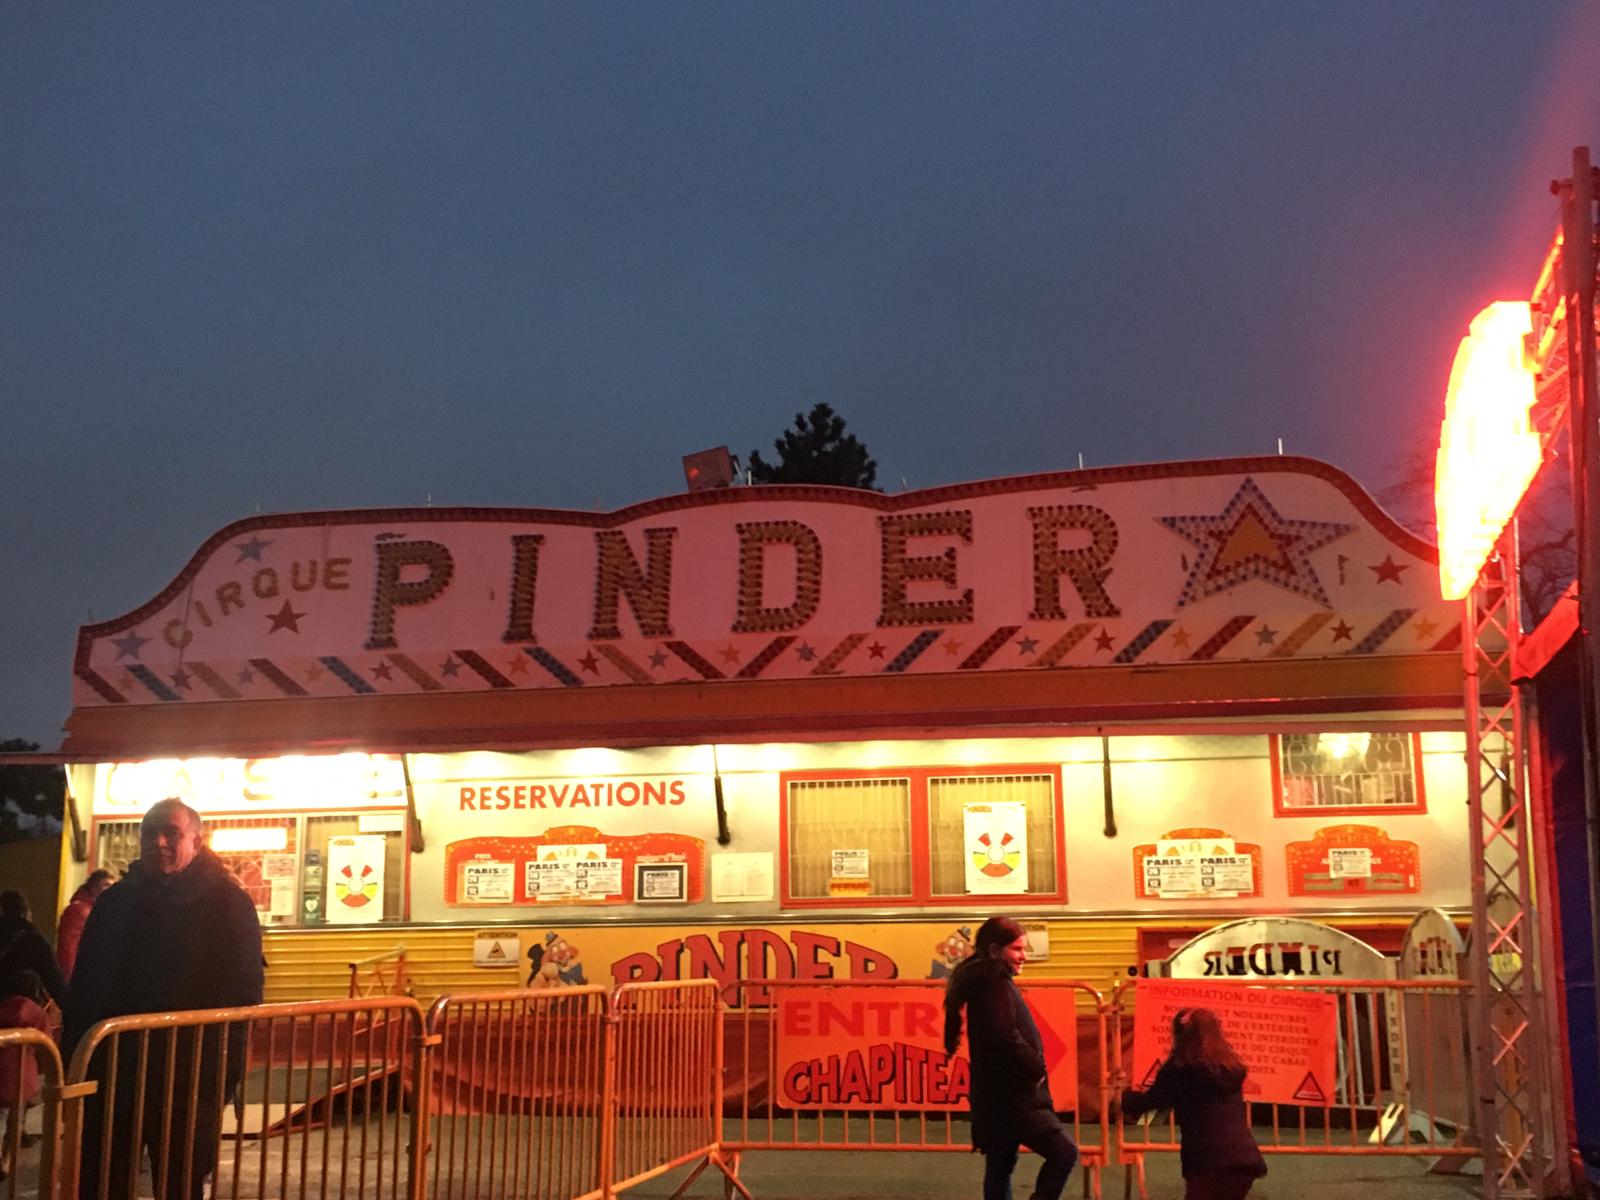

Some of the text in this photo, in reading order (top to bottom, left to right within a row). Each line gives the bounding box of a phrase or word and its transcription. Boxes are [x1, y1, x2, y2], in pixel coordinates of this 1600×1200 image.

[163, 504, 1120, 649] CIRQUE PINDER
[460, 781, 685, 810] RESERVATIONS
[576, 861, 608, 869] PARIS
[1149, 985, 1322, 1008] INFORMATION DU CIRQUE
[784, 1001, 942, 1037] ENTR
[1251, 1043, 1266, 1053] DU
[783, 1042, 970, 1104] CHAPITEA
